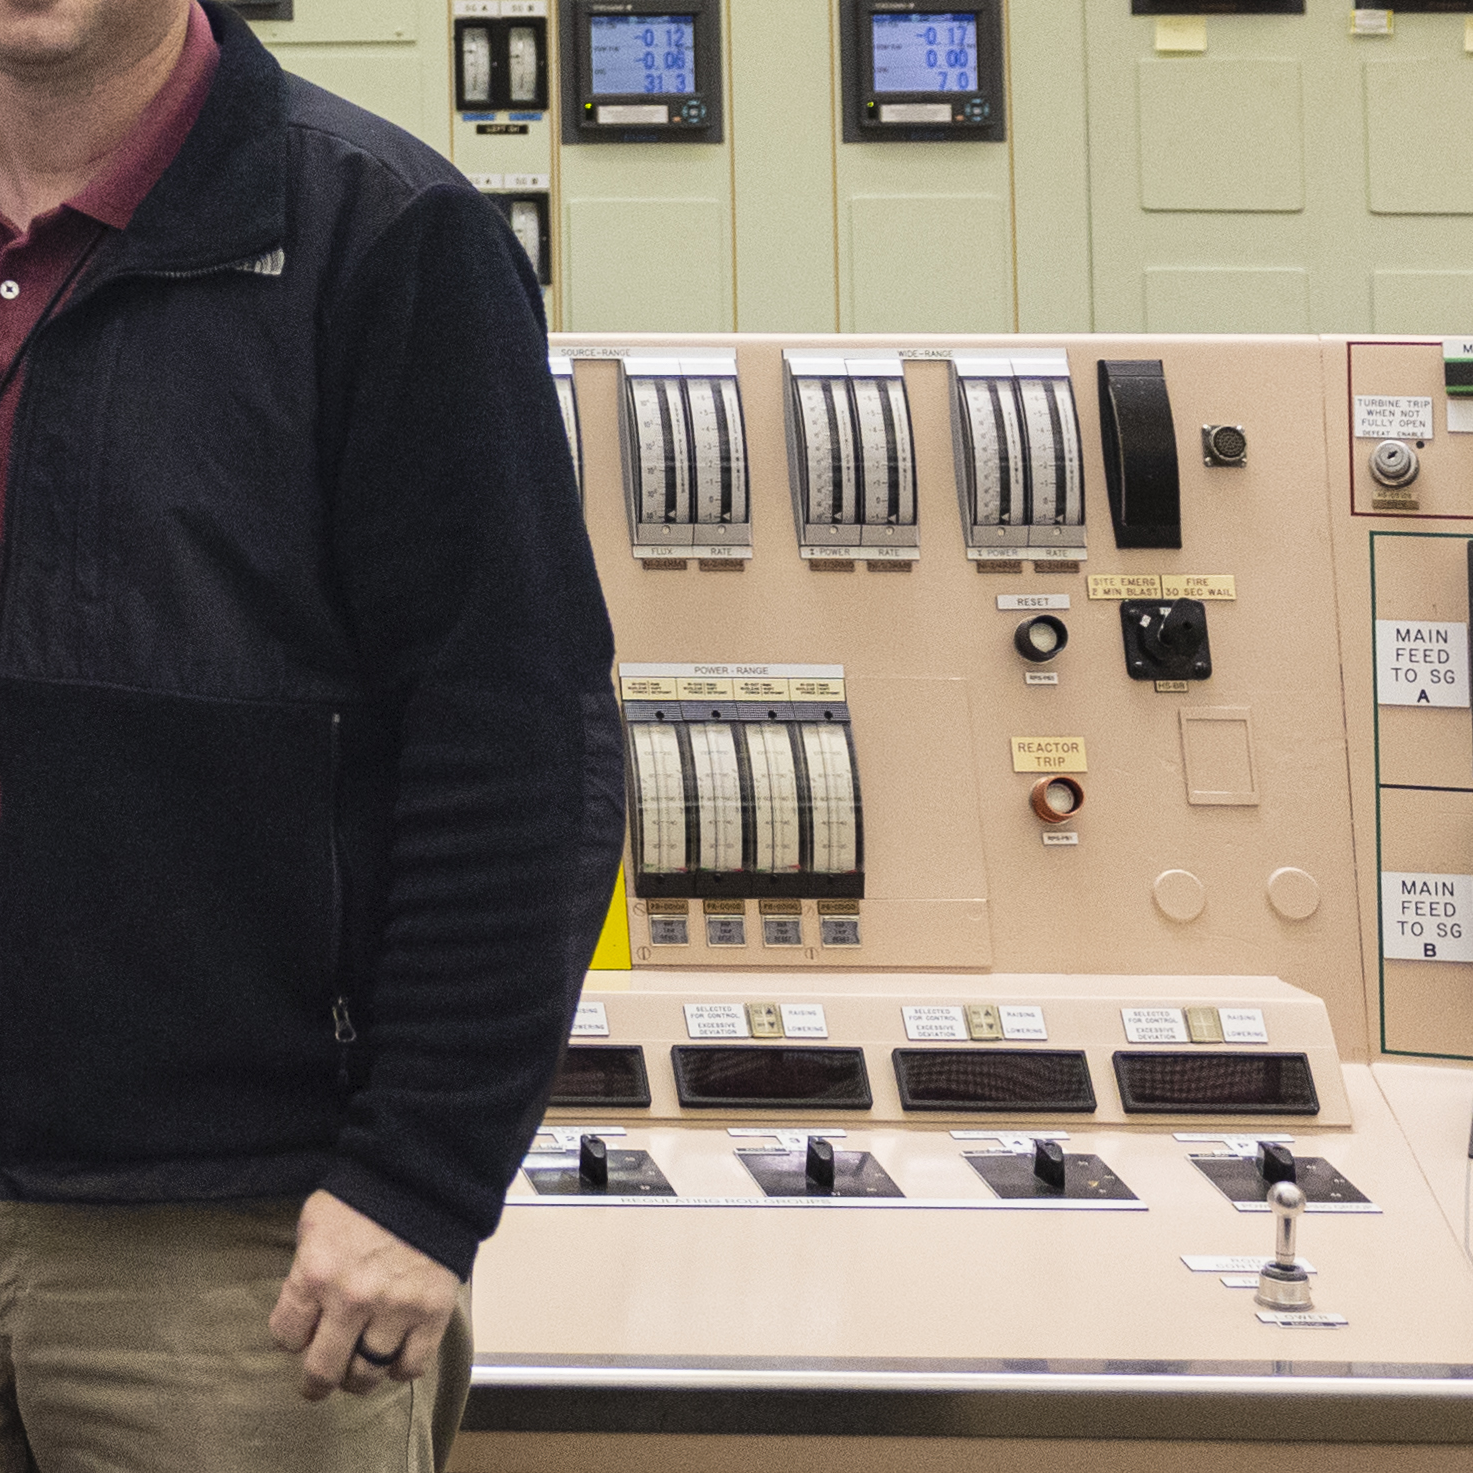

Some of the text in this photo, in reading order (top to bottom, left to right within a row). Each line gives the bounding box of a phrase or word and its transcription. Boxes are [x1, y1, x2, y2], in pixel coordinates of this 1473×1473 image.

[561, 349, 631, 357] SOURCE-RANGE
[898, 350, 953, 358] WIDE-RANGE
[1358, 399, 1429, 409] TURBINE TRIP
[1367, 409, 1421, 418] WHEN NOT
[1361, 419, 1425, 428] FULLY OPEN
[819, 548, 850, 556] POWER
[1093, 578, 1156, 586] SITE EMERG
[1186, 578, 1208, 586] FIRE
[1092, 588, 1158, 596] 2 MIN BLAST
[1165, 588, 1233, 597] 30 SEC WAIL
[1396, 629, 1448, 643] MAIN
[1396, 649, 1450, 663] FEED
[694, 666, 728, 674] POWER
[737, 666, 769, 674] RANGE
[1391, 668, 1455, 684] TO SG
[1417, 690, 1430, 703] A
[1018, 743, 1079, 753] REACTOR
[1035, 757, 1065, 767] TRIP
[1402, 881, 1454, 895] MAIN
[1402, 902, 1456, 916] FEED
[1398, 921, 1462, 938] TO SG
[1424, 943, 1436, 957] B
